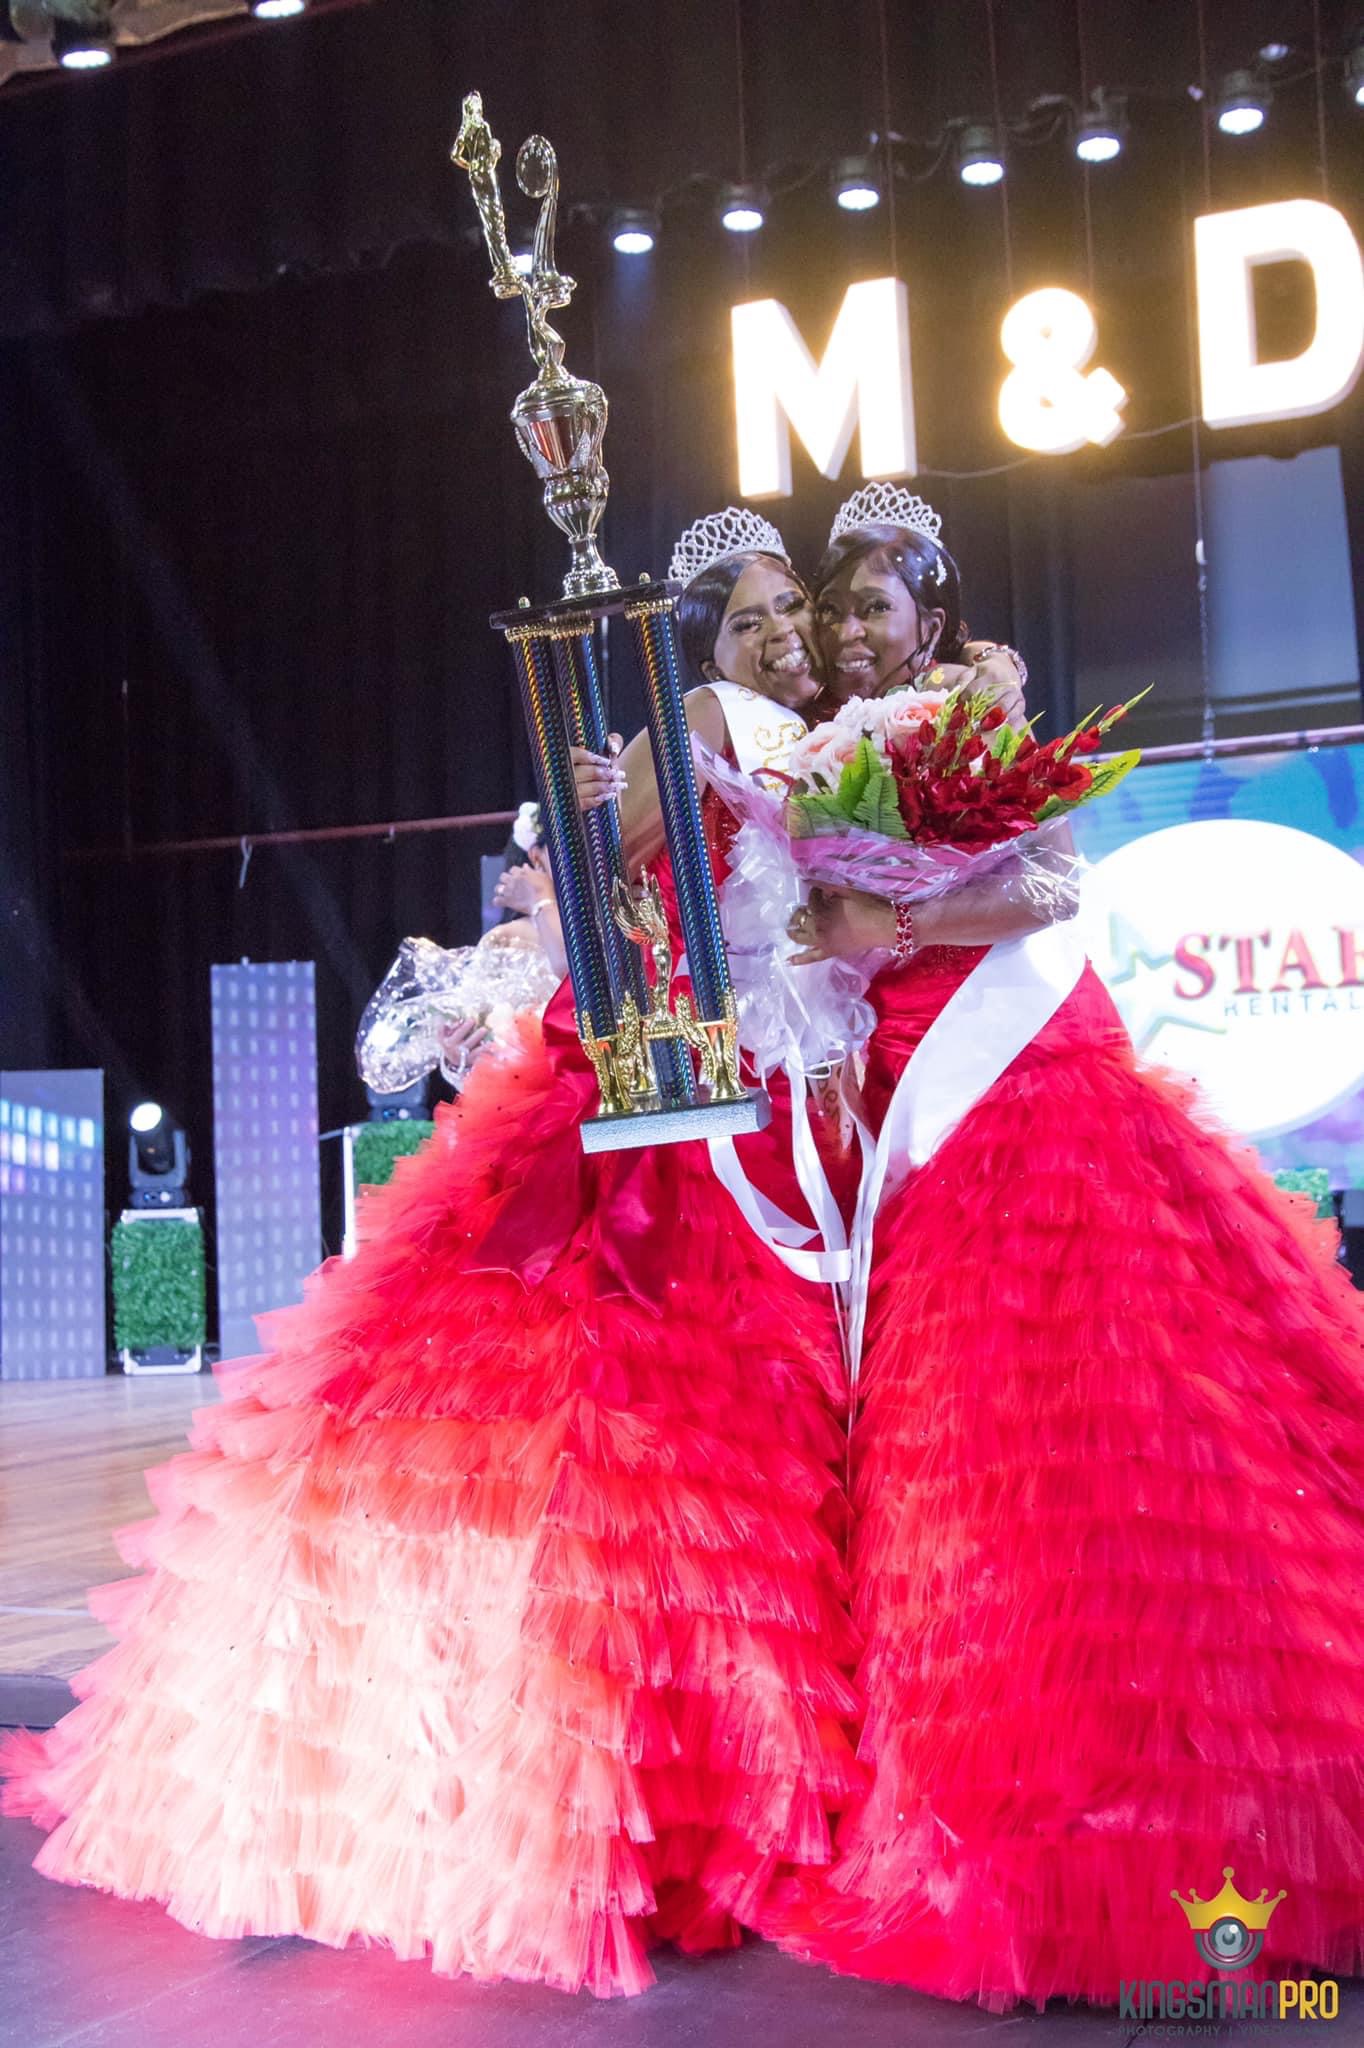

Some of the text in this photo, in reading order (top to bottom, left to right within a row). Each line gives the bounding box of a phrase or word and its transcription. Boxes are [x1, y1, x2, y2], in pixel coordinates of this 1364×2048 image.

[728, 198, 1364, 498] M & D
